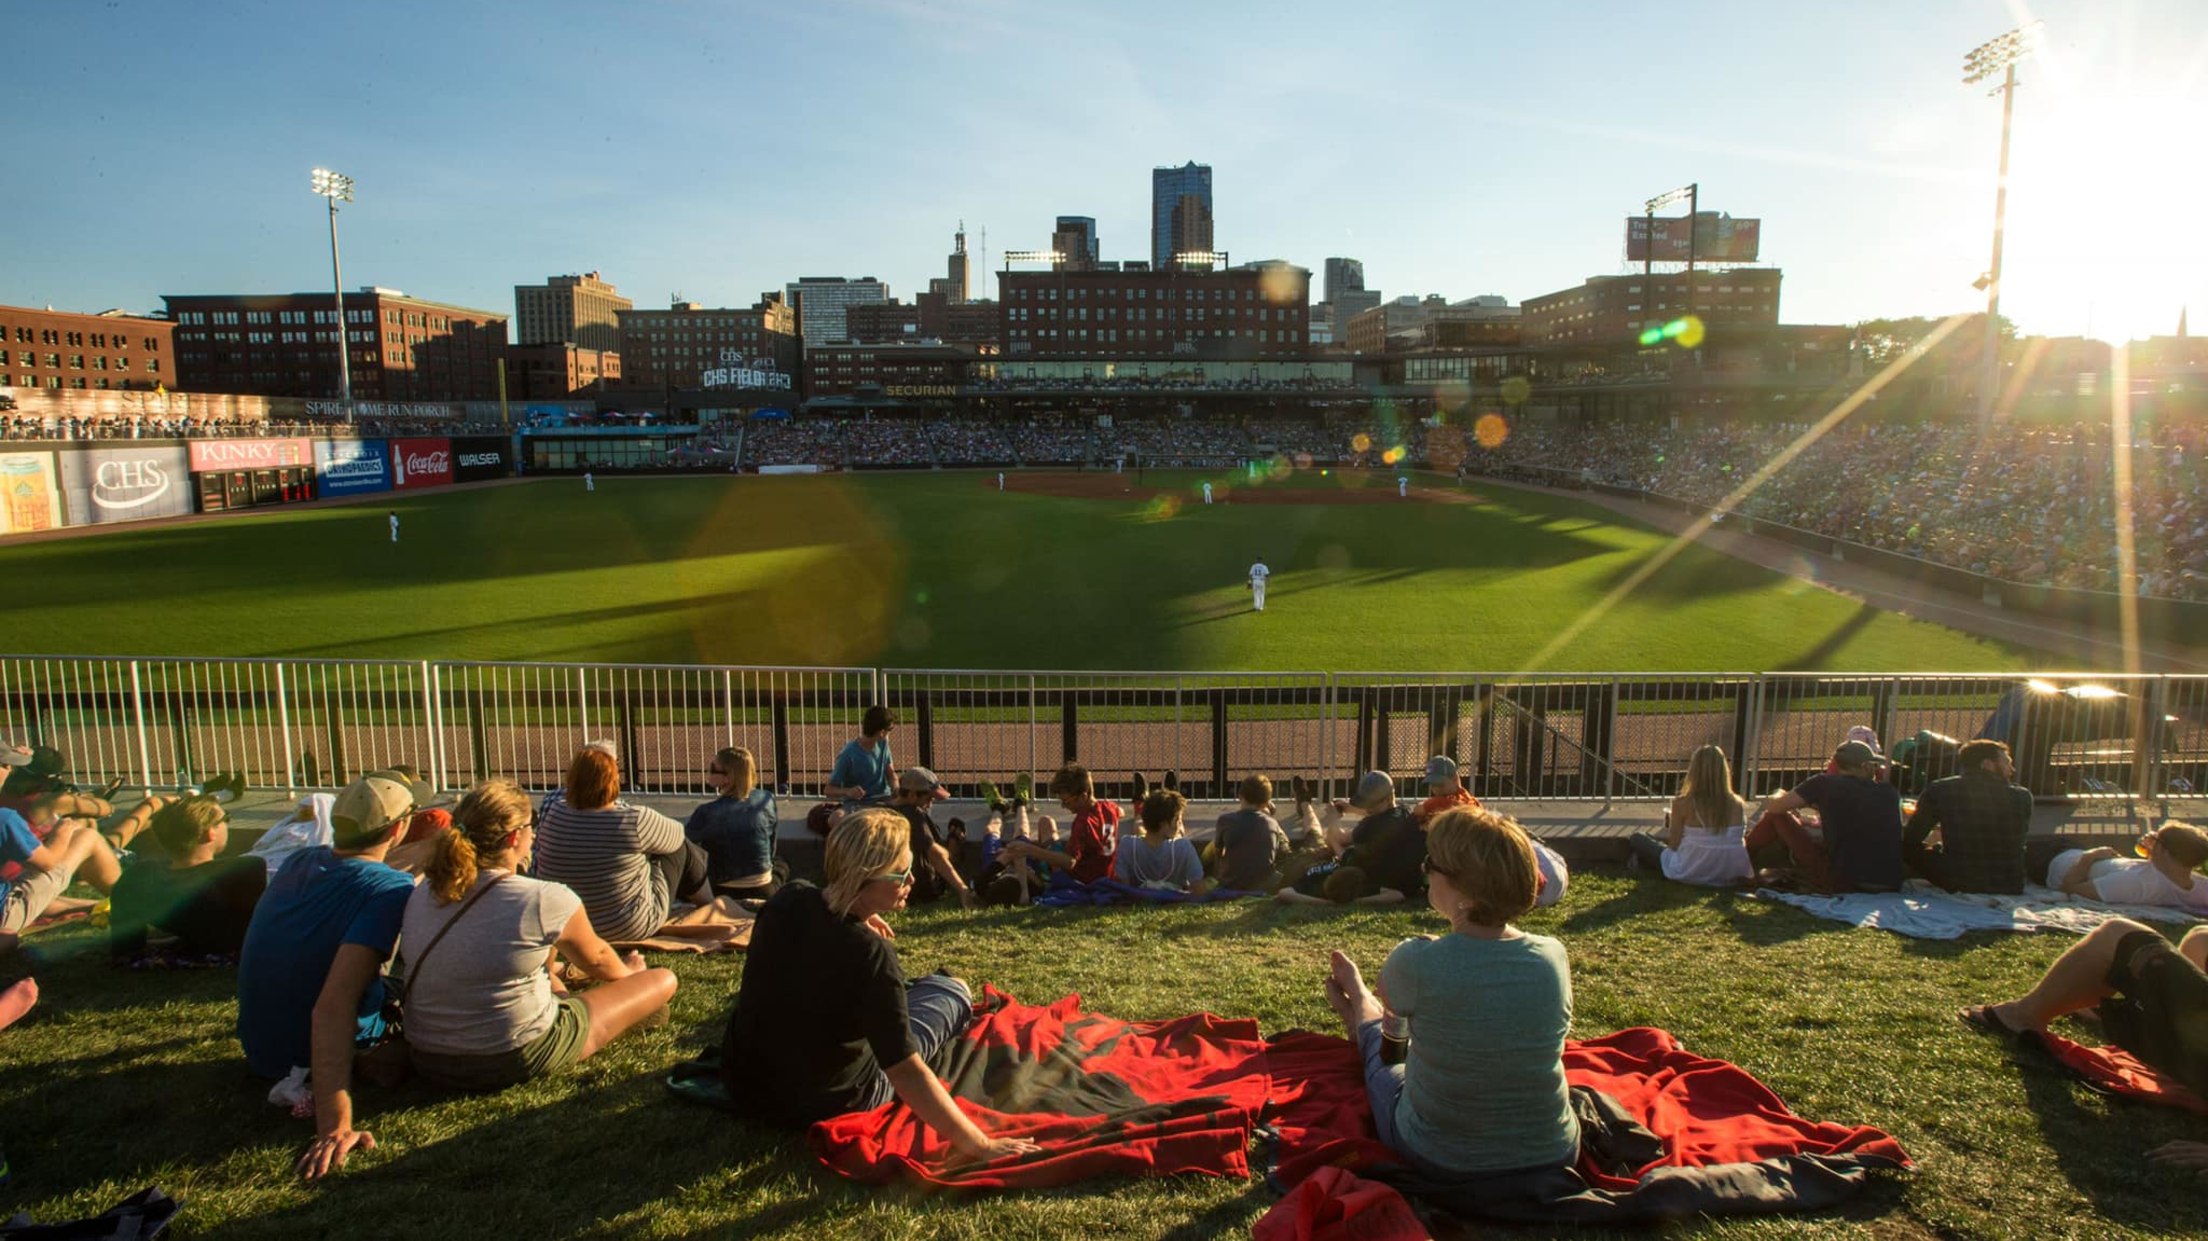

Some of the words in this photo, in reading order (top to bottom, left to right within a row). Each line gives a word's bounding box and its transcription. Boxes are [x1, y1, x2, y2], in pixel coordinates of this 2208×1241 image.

[703, 368, 728, 387] CHS
[886, 385, 957, 397] SECURIAN
[305, 401, 343, 416] SPIRE
[387, 404, 411, 417] RUN
[413, 404, 450, 417] PORCH
[200, 442, 276, 463] KINKY
[458, 452, 501, 467] WALSER
[97, 459, 161, 490] CHS
